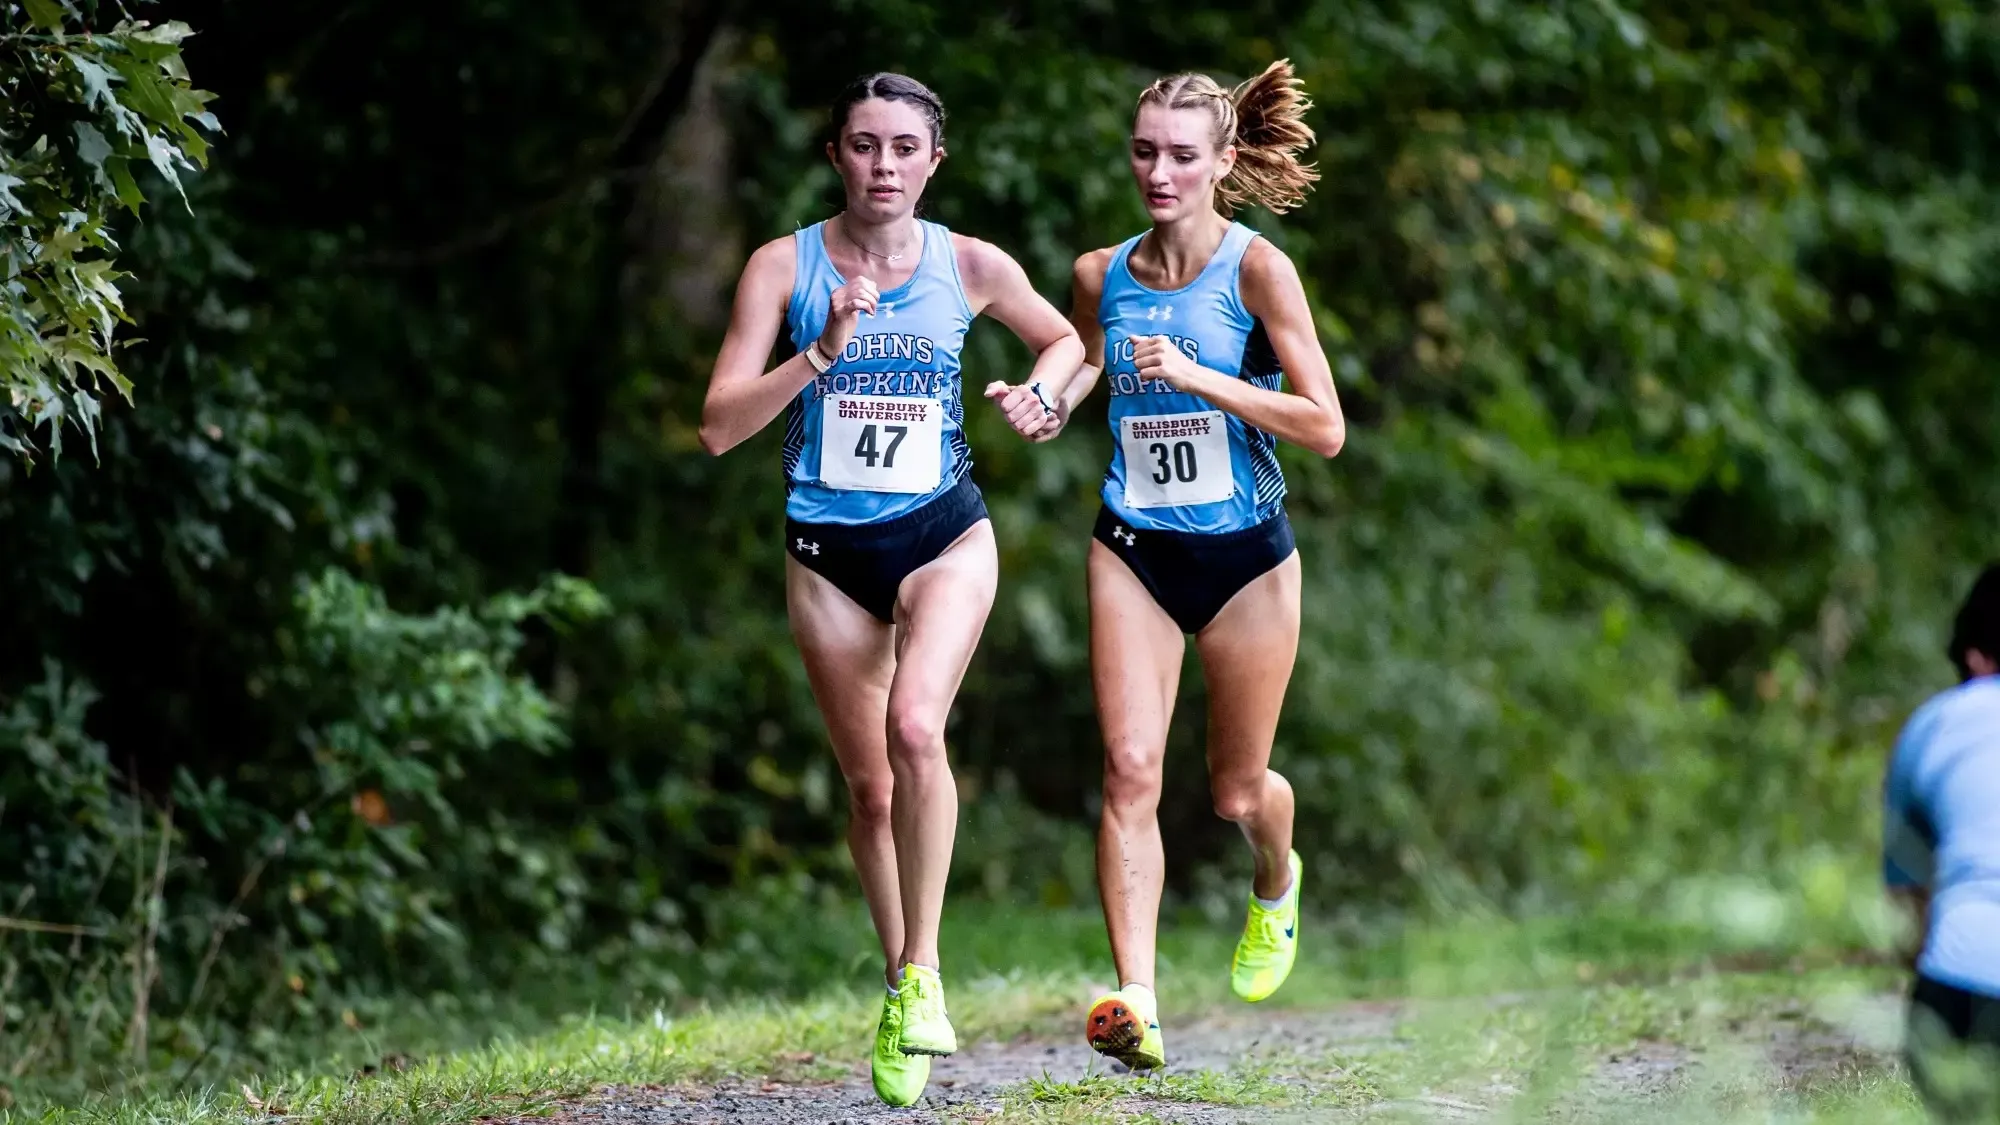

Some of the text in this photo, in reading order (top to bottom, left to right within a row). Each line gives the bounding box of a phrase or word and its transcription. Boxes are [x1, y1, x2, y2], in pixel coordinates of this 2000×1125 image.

[831, 333, 934, 367] OHNS
[1112, 333, 1199, 366] JOS
[838, 400, 928, 413] SALISBURY
[838, 410, 927, 422] UNIVERSITY
[1132, 417, 1210, 431] SALISBURY
[1132, 426, 1211, 440] UNIVERSITY
[854, 424, 908, 468] 47
[1149, 441, 1198, 485] 30
